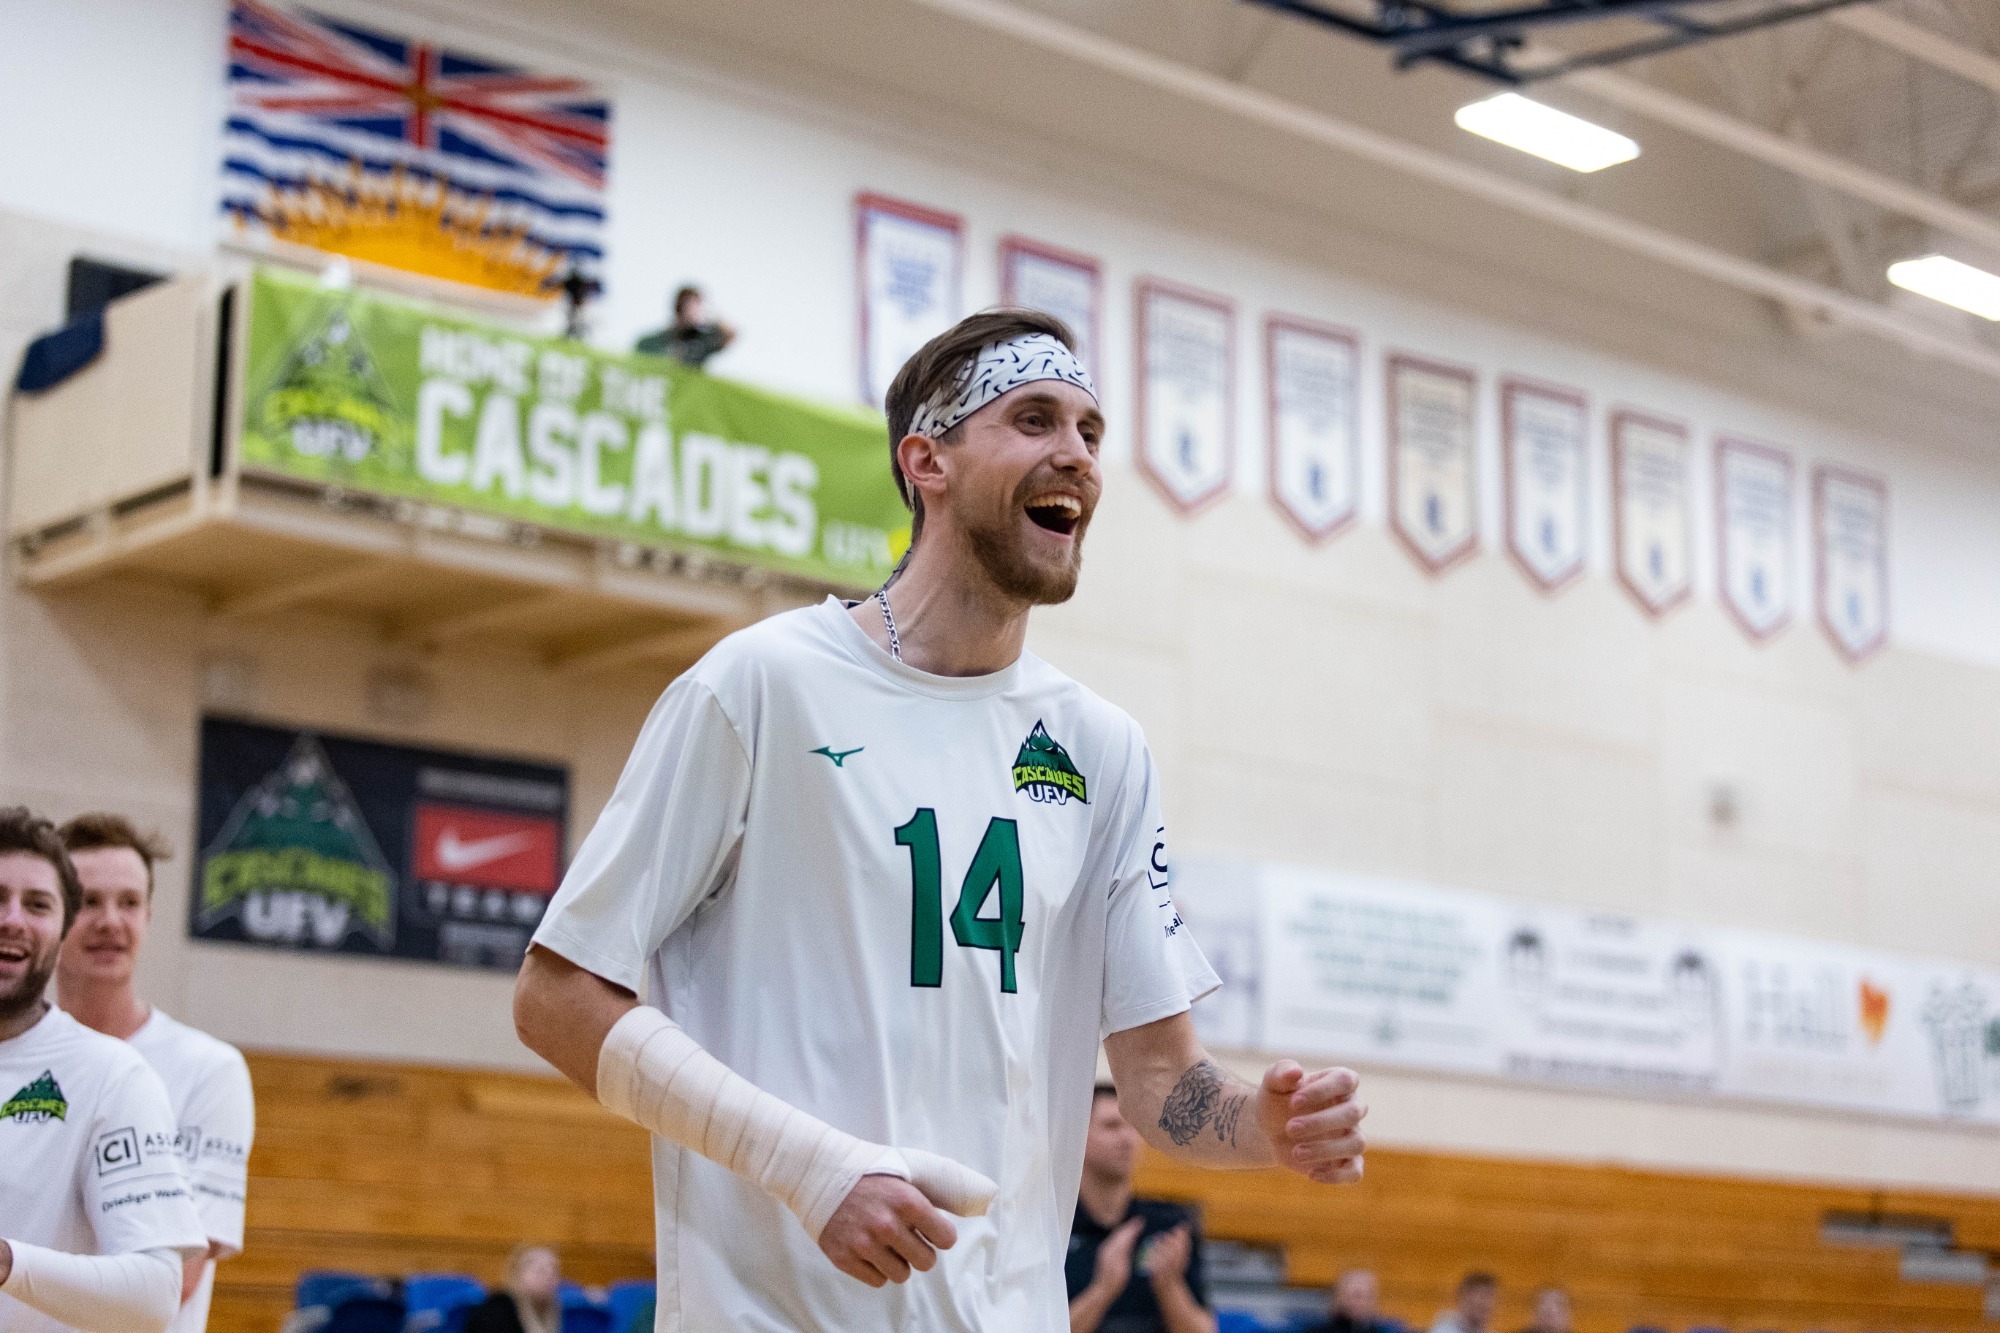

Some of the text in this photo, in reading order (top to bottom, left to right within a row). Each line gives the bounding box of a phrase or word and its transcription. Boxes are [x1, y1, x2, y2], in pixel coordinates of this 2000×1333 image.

[420, 325, 668, 420] HOME OF THE
[417, 378, 818, 557] CASCADES
[1012, 765, 1085, 801] CASCADES
[1027, 783, 1068, 805] UFV
[241, 891, 351, 947] UFV
[894, 807, 1025, 993] 14
[103, 1138, 131, 1163] CI
